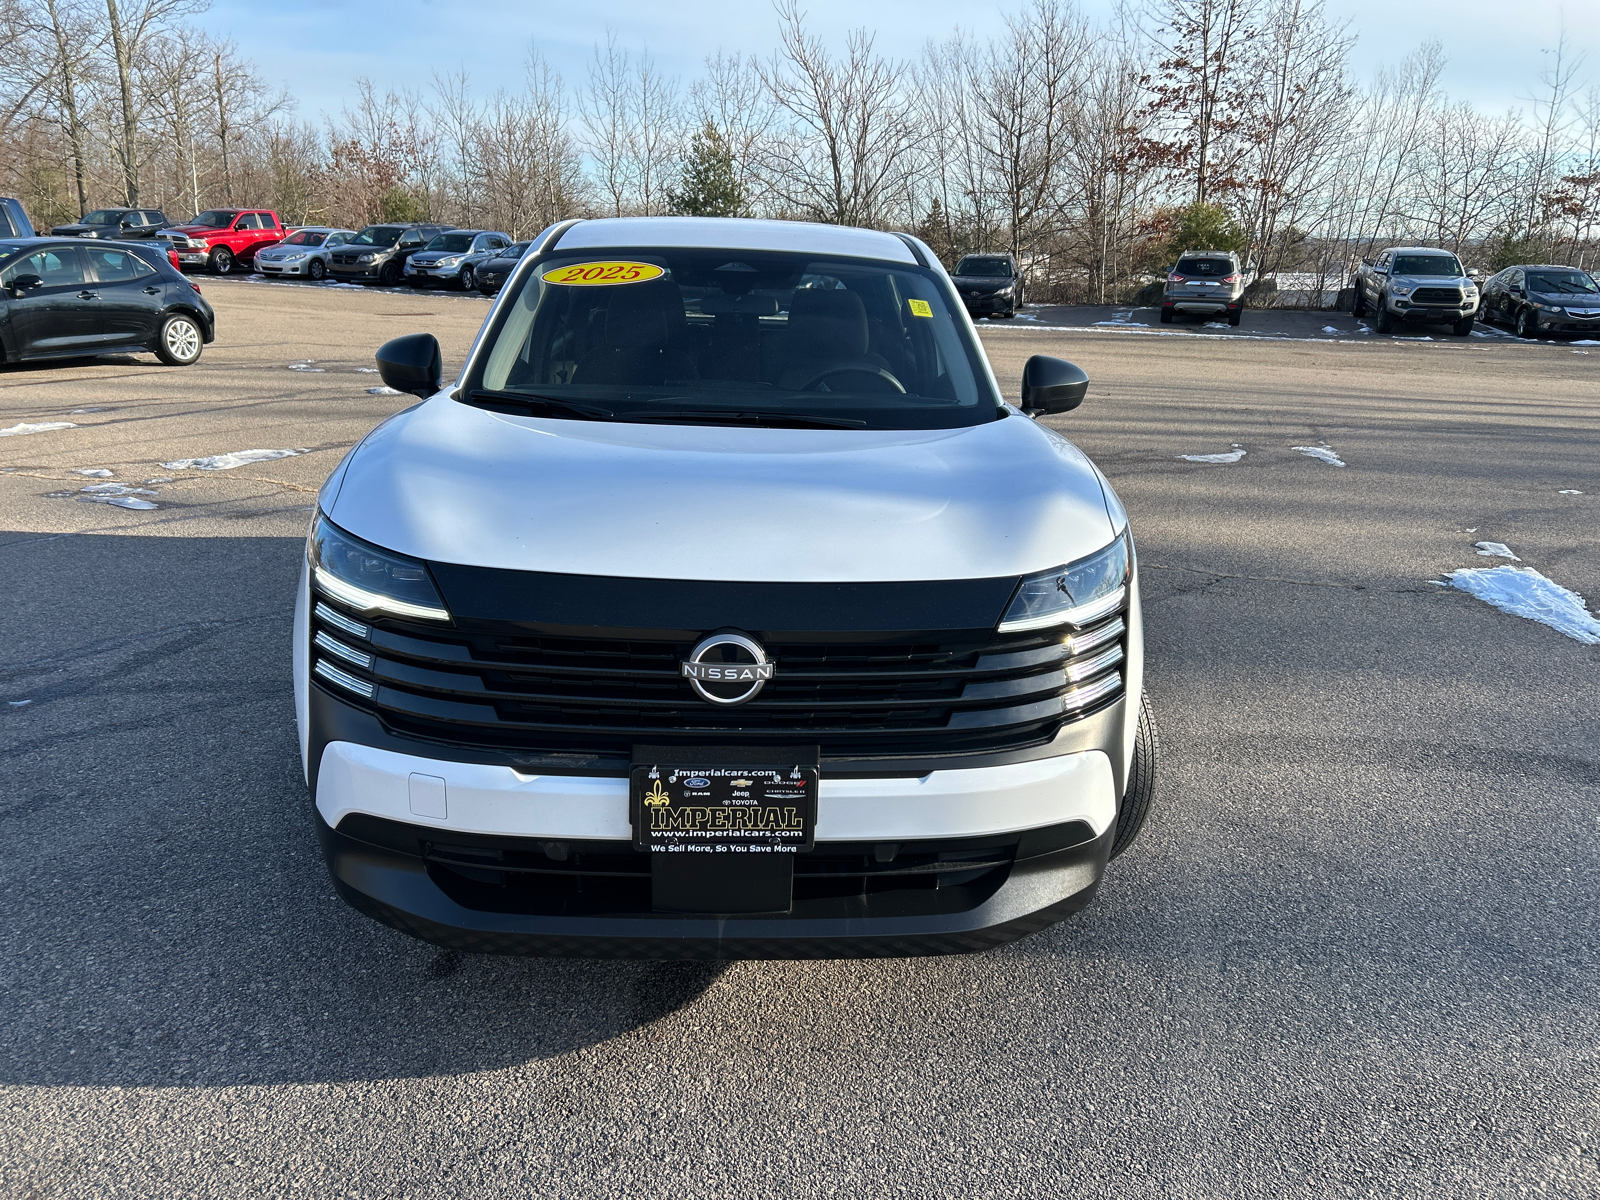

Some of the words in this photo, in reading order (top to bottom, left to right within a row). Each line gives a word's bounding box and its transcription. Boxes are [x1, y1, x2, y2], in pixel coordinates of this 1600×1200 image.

[560, 265, 646, 282] 2025
[684, 664, 770, 680] NISSAN
[674, 768, 776, 778] Imperialcars.com
[731, 790, 750, 798] Jeep
[650, 806, 803, 830] IMPERIAL
[650, 829, 803, 838] www.imperialcars.com
[650, 844, 666, 852] We
[667, 844, 685, 852] Sell
[687, 844, 713, 853] More,
[730, 844, 748, 852] You
[749, 845, 772, 853] Save
[773, 845, 797, 853] More
